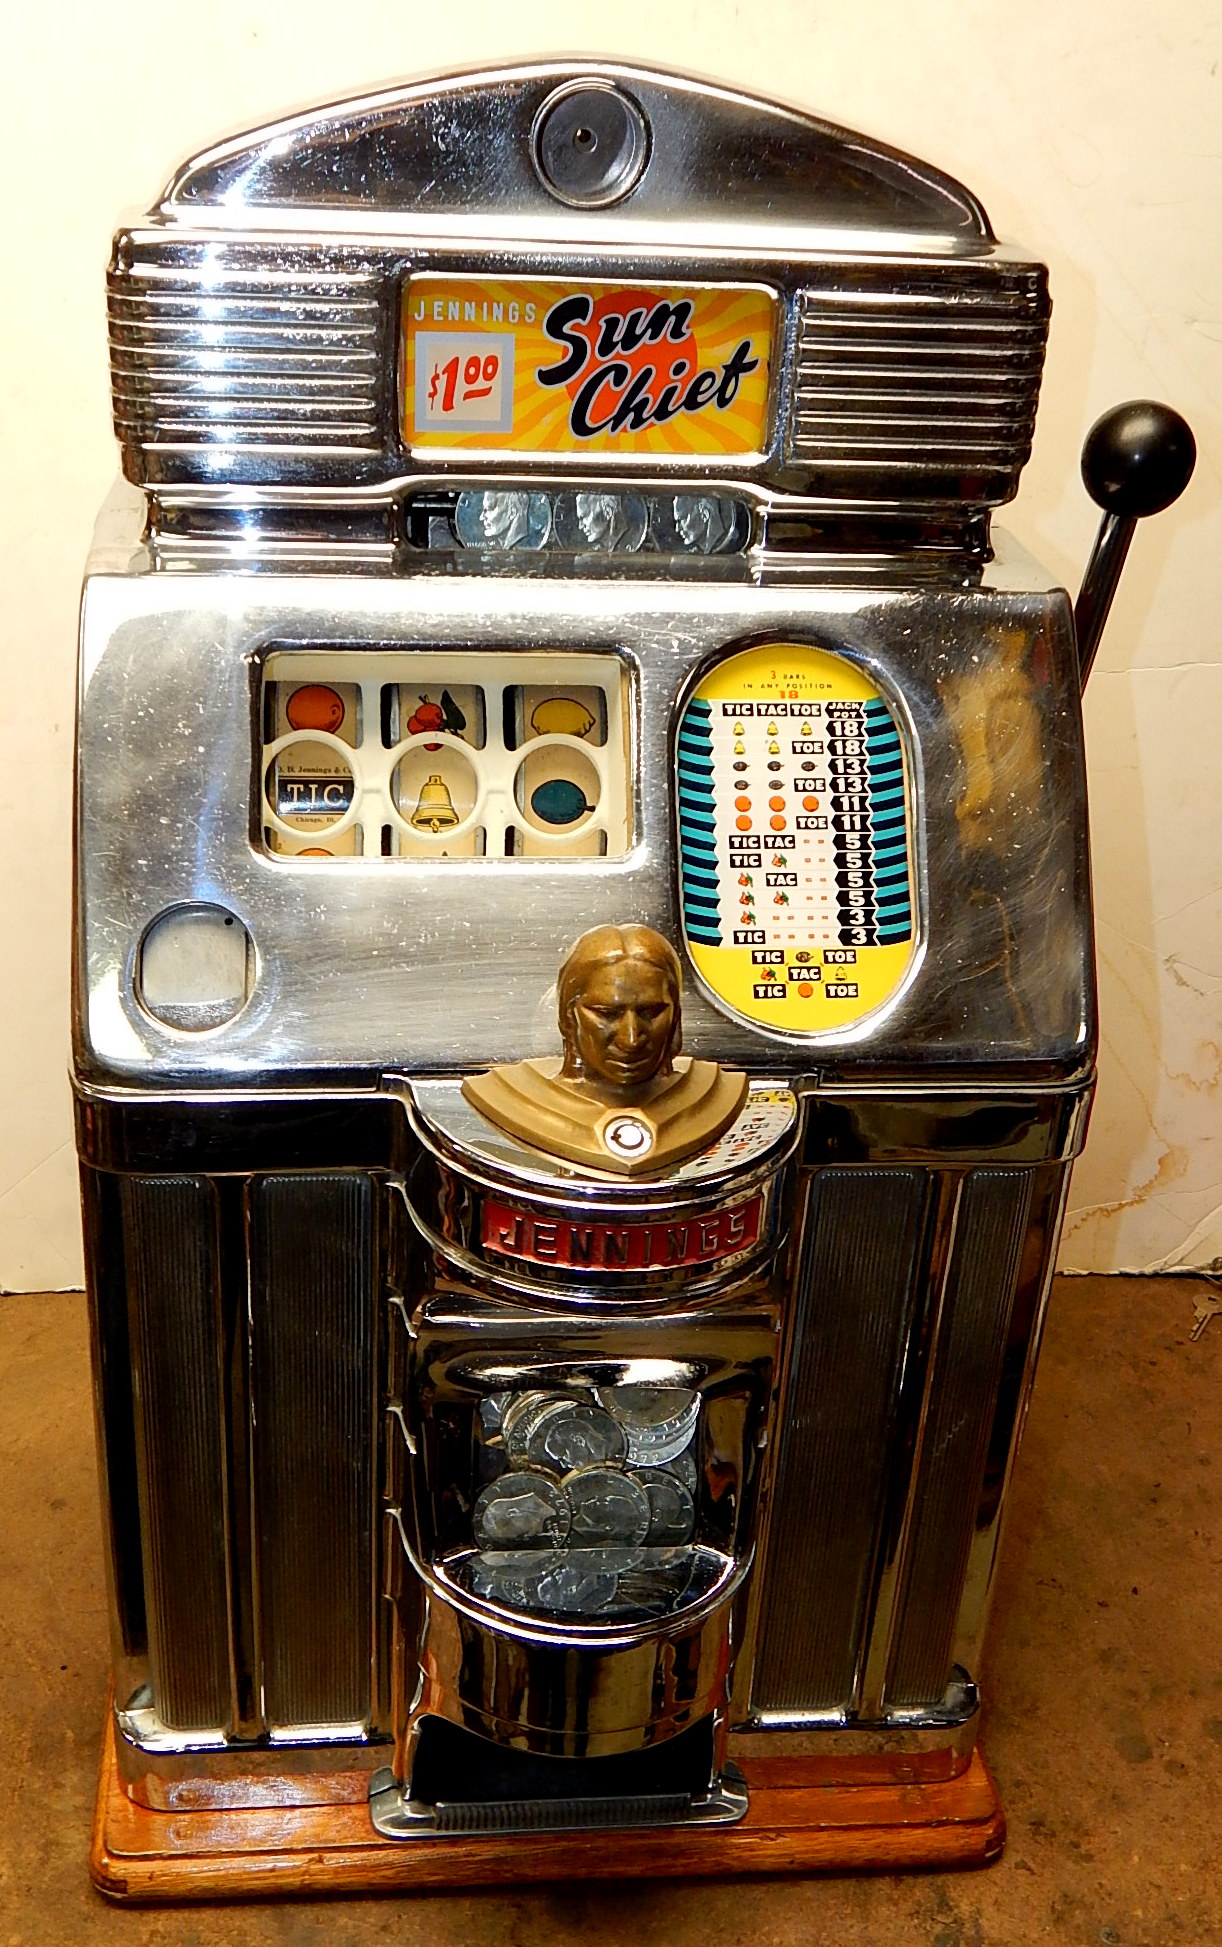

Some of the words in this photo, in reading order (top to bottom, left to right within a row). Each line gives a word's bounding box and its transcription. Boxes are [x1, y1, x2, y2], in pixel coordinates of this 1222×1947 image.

[414, 300, 537, 324] JENNINGS
[535, 293, 695, 388] Sun
[567, 338, 760, 440] Chief
[770, 670, 777, 680] 3
[779, 690, 799, 699] 18
[724, 704, 752, 716] TIC
[758, 704, 787, 716] TAC
[791, 704, 820, 716] TOE
[828, 701, 860, 710] JACK
[832, 720, 859, 737] 18
[793, 742, 823, 753] TOE
[834, 739, 861, 756] 18
[298, 766, 332, 775] Jennings
[835, 758, 862, 774] 13
[795, 779, 825, 791] TOE
[836, 777, 863, 793] 13
[286, 783, 345, 807] TIC
[839, 796, 861, 812] 11
[797, 817, 827, 829] TOE
[840, 814, 862, 831] 11
[731, 836, 759, 848] TIC
[765, 836, 794, 848] TAC
[845, 834, 861, 850] 5
[732, 855, 760, 867] TIC
[845, 852, 863, 869] 5
[767, 874, 796, 886] TAC
[847, 871, 864, 888] 5
[848, 890, 866, 907] 5
[849, 908, 866, 925] 3
[736, 931, 764, 943] TIC
[850, 928, 868, 945] 3
[754, 951, 782, 963] TIC
[825, 951, 855, 963] TOE
[789, 968, 820, 980] TAC
[755, 985, 784, 998] TIC
[827, 985, 858, 997] TOE
[498, 1208, 747, 1266] JENNINGS
